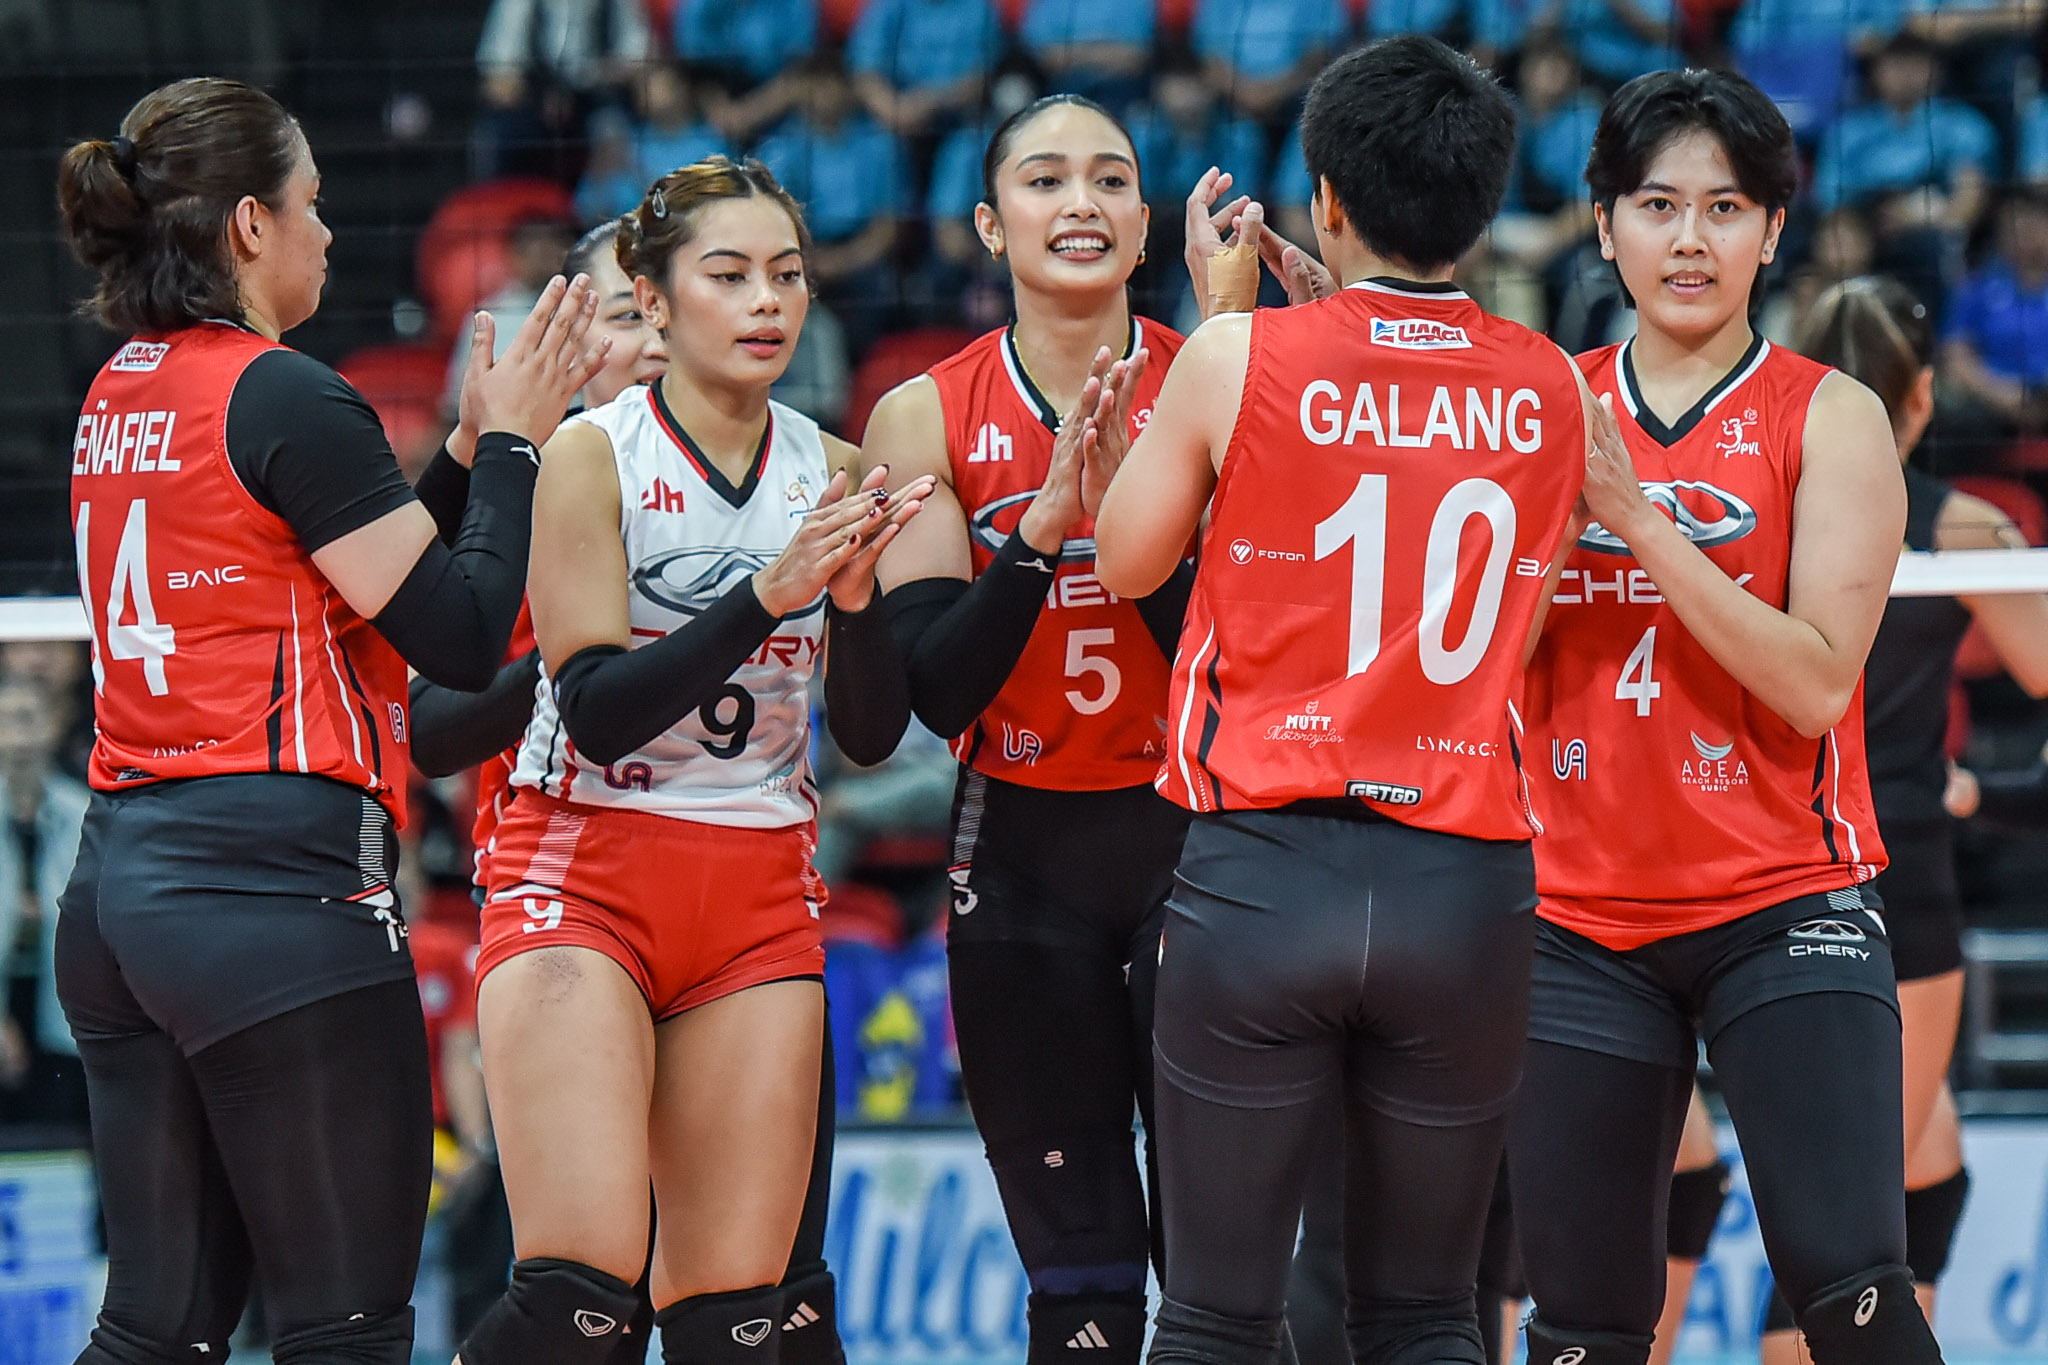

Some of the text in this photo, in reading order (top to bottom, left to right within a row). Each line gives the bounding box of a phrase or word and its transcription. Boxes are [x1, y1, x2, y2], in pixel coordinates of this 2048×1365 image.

[1299, 379, 1543, 455] GALANG
[72, 398, 182, 475] EÑAFIEL
[1740, 441, 1761, 456] PVL
[1258, 549, 1306, 562] FOTON
[167, 565, 246, 590] BAIC
[1313, 473, 1517, 686] 10
[75, 497, 176, 698] 14
[1064, 627, 1121, 716] 5
[1615, 626, 1661, 717] 4
[698, 683, 756, 760] 9
[1263, 725, 1344, 749] Motorcycles
[1285, 714, 1332, 731] MUTT
[1681, 759, 1749, 778] ACEA
[522, 897, 564, 935] 9
[1788, 943, 1871, 962] CHERY
